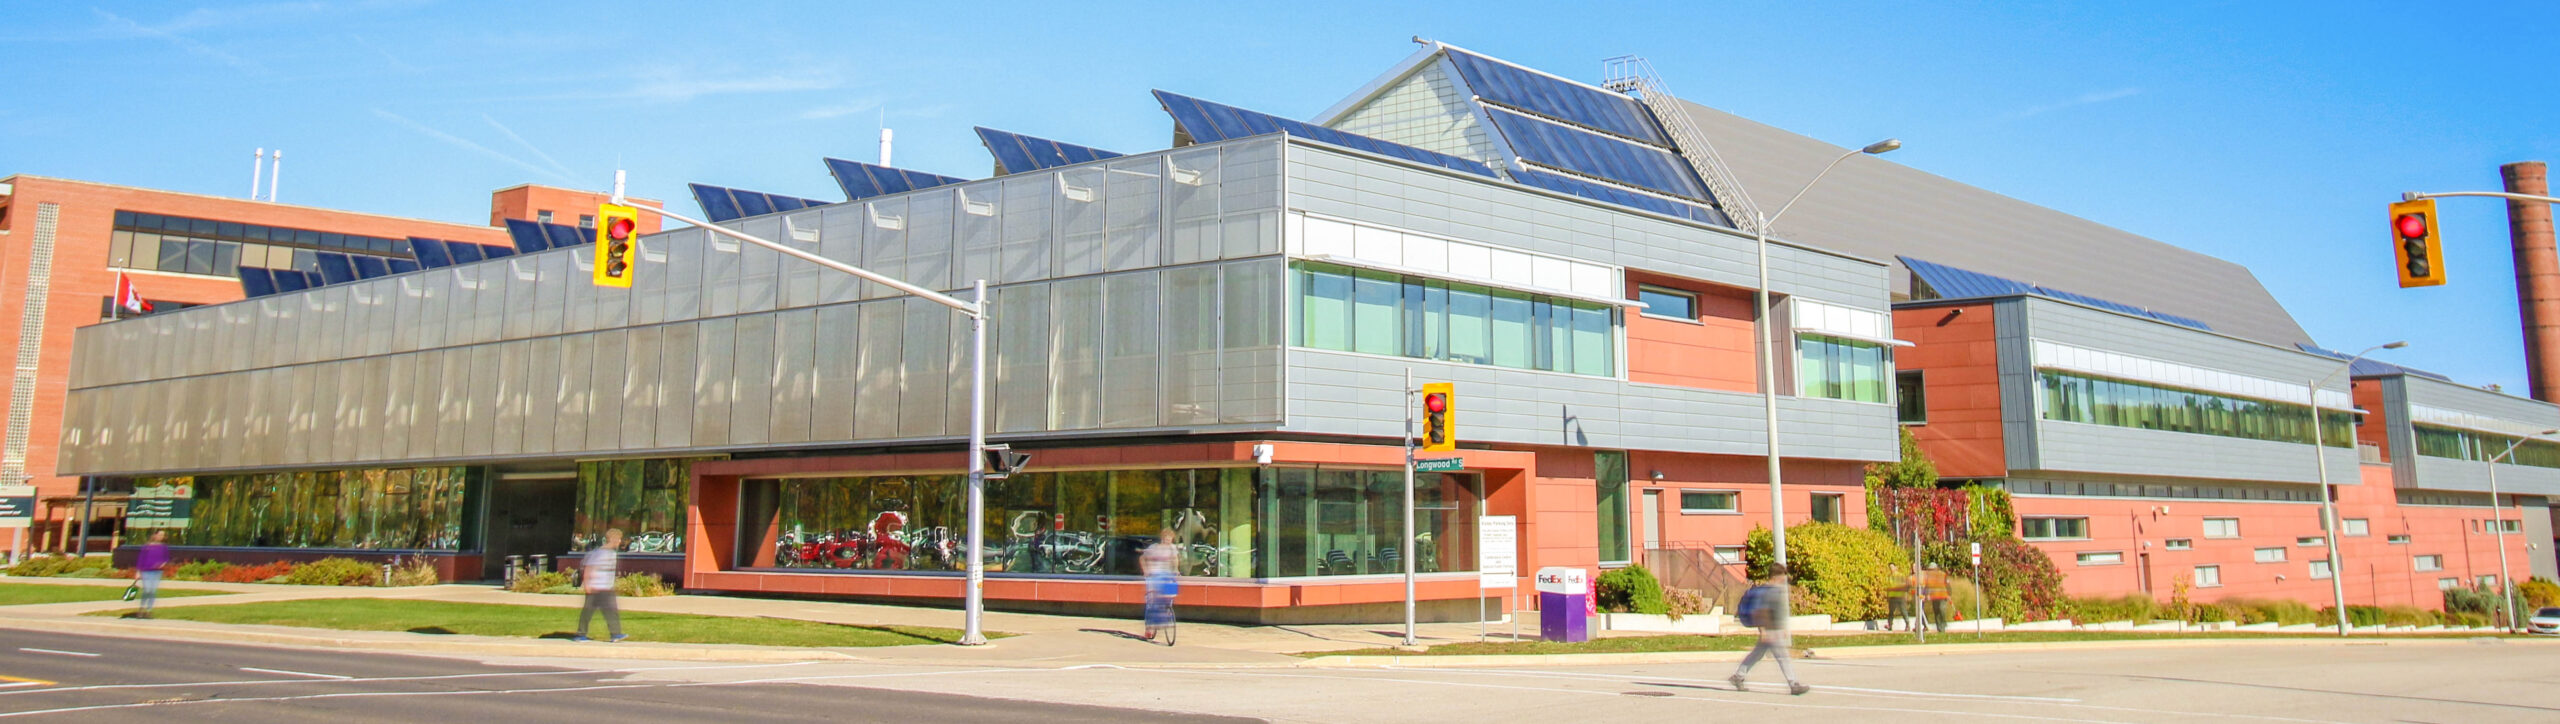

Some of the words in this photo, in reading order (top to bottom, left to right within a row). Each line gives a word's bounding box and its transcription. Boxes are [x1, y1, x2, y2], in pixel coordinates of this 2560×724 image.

[1416, 460, 1451, 471] Longwood
[1458, 458, 1464, 468] S
[1538, 574, 1562, 584] FedEx
[1568, 574, 1584, 584] FedEx
